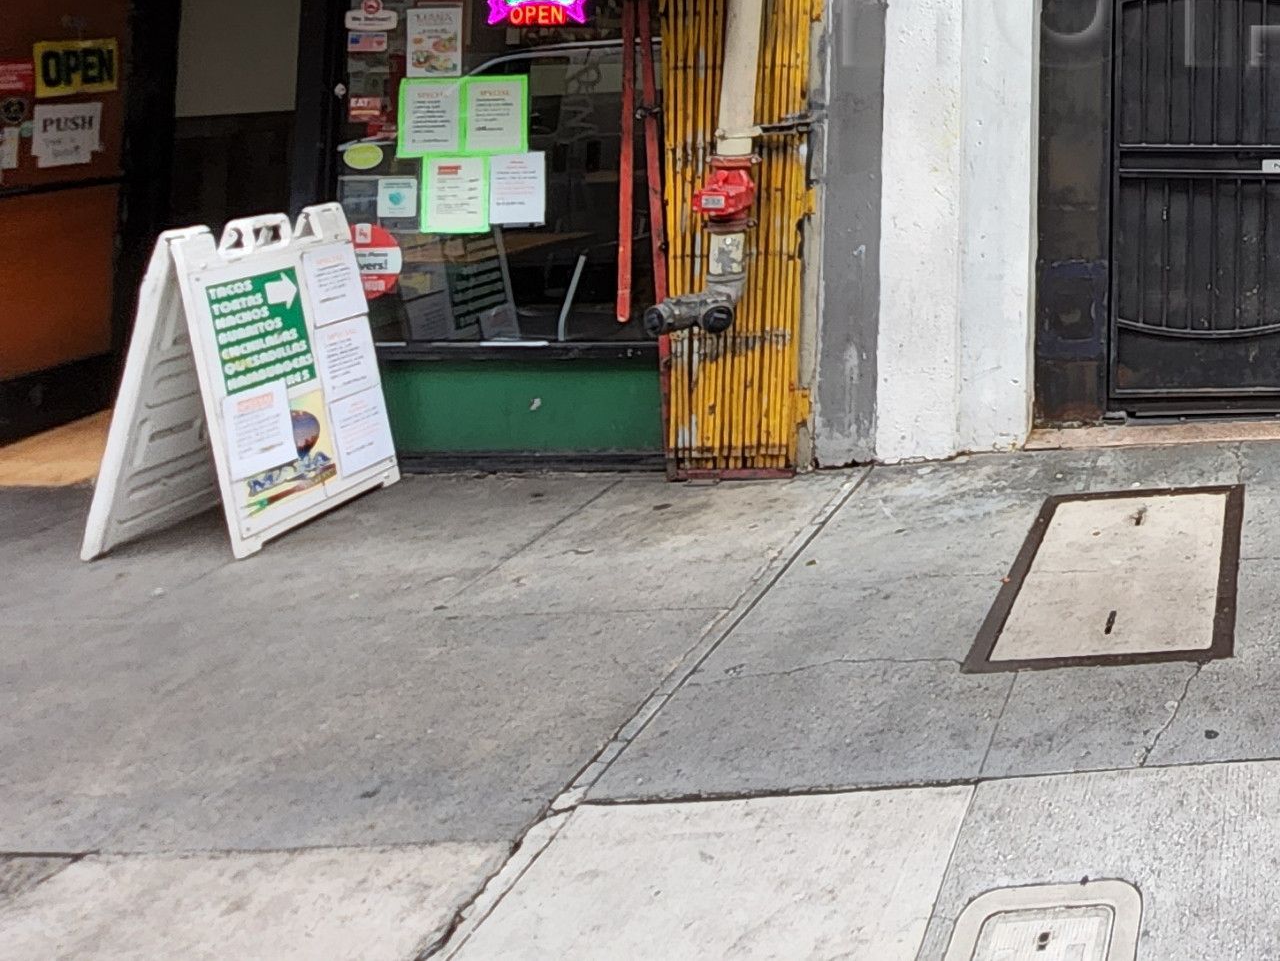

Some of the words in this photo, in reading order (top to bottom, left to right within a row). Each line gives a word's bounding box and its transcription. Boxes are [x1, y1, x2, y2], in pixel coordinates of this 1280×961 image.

[510, 5, 565, 24] OPEN
[41, 48, 114, 88] OPEN
[42, 115, 94, 133] PUSH
